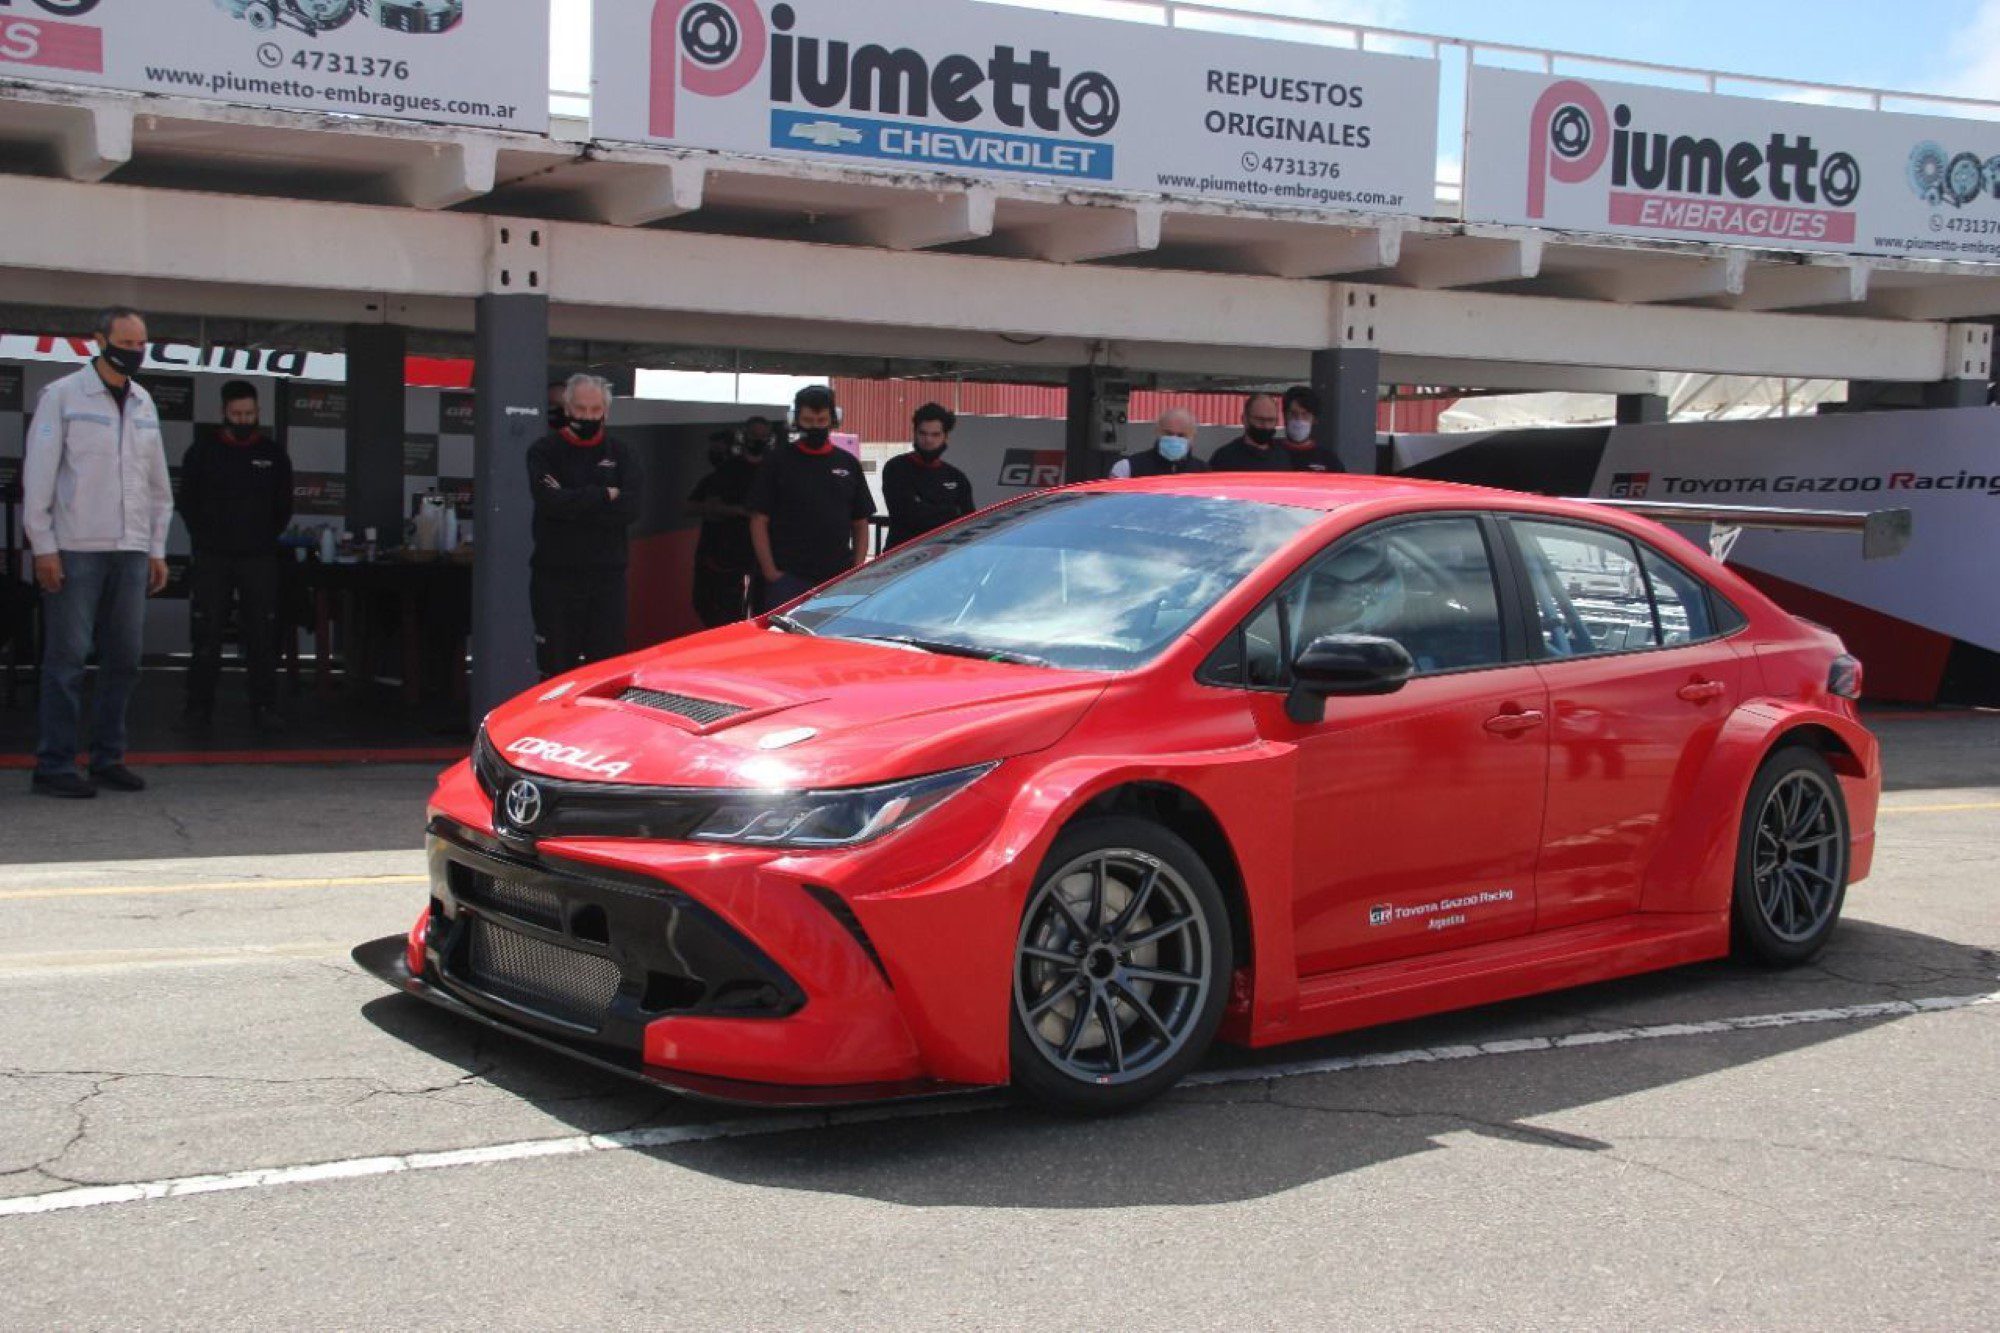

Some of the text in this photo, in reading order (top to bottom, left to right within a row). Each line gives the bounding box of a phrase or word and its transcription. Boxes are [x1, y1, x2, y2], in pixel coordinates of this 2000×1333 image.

[290, 49, 410, 81] 4731376
[649, 0, 1120, 138] Piumetto
[145, 65, 518, 119] www.piumetto-embragues.com.ar
[1206, 68, 1363, 109] REPUESTOS
[1204, 109, 1371, 149] ORIGINALES
[879, 128, 1096, 174] CHEVROLET
[1261, 155, 1340, 179] 4731376
[1526, 79, 1862, 220] Piumetto
[1157, 172, 1404, 207] www.piumetto-embragues.com.ar
[1638, 201, 1829, 239] EMBRAGUES
[1662, 476, 1768, 494] TOYOTA
[1772, 475, 1882, 493] GAZOO
[1886, 469, 2000, 496] Racing
[505, 736, 633, 778] COROLLA
